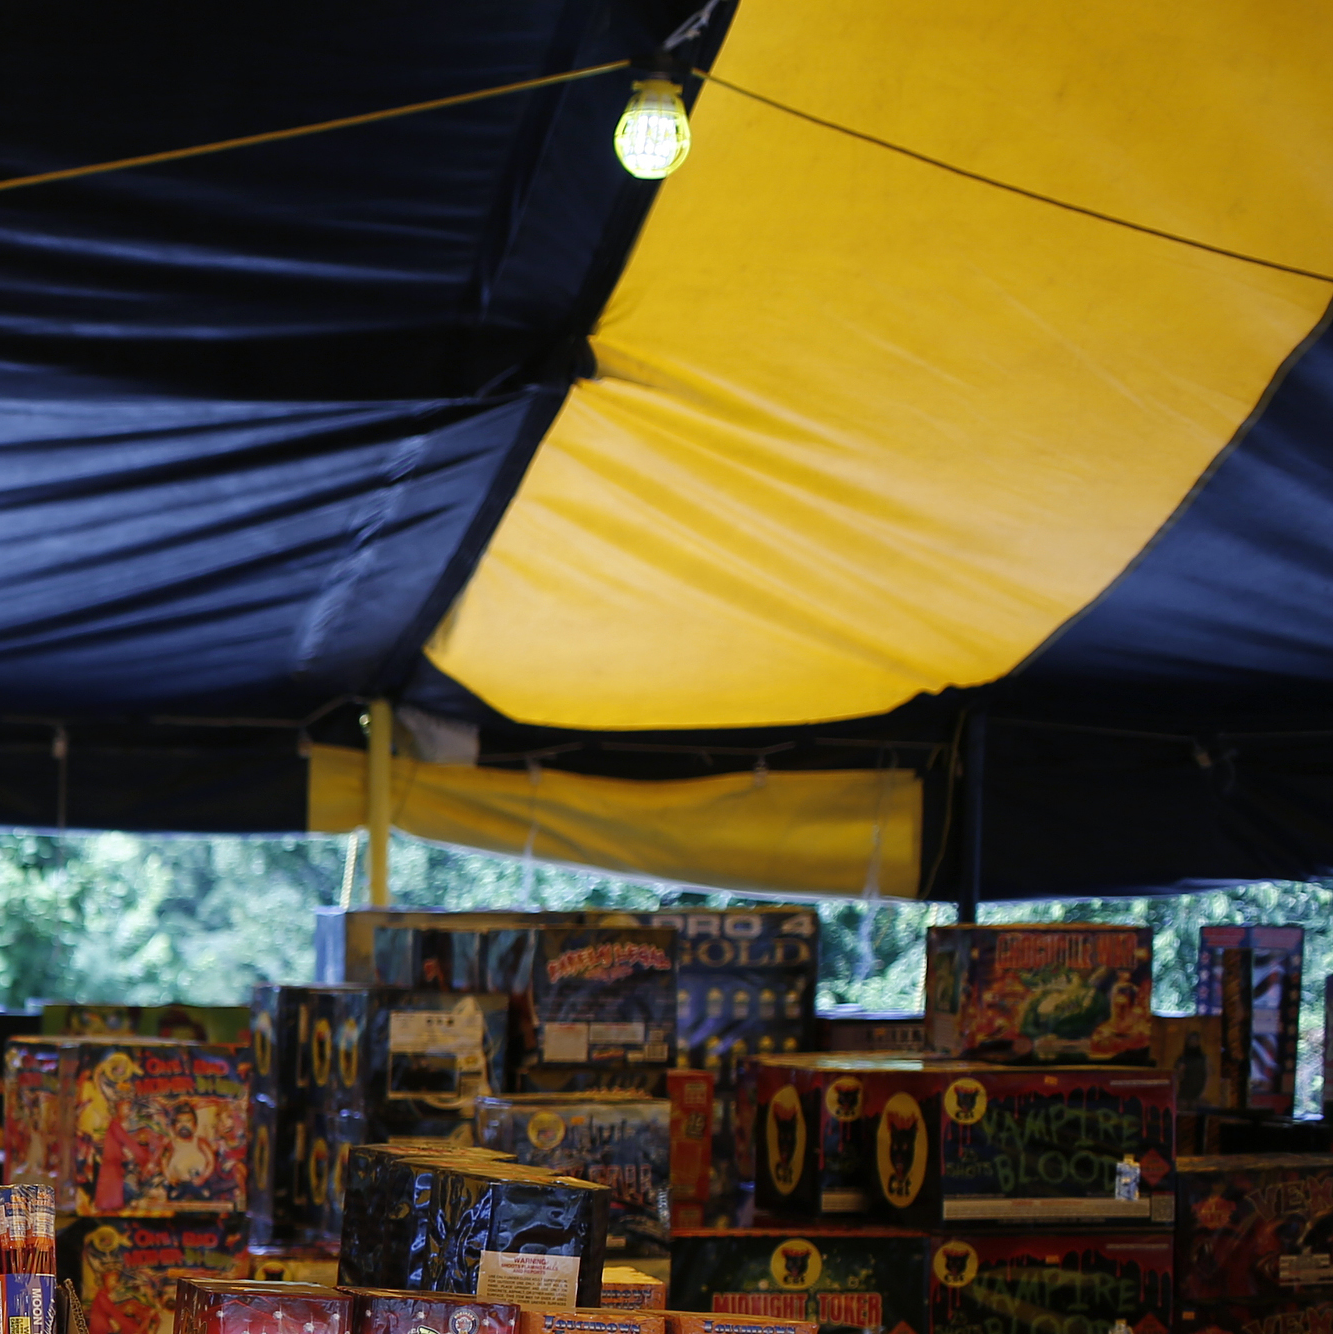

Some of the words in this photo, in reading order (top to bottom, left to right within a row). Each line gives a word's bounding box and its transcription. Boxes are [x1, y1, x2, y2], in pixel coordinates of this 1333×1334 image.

[983, 1103, 1139, 1149] VAMPIRE
[712, 1291, 806, 1321] MIDNIGHT
[818, 1292, 882, 1327] TOKER
[970, 1269, 1136, 1312] VAMPIRE
